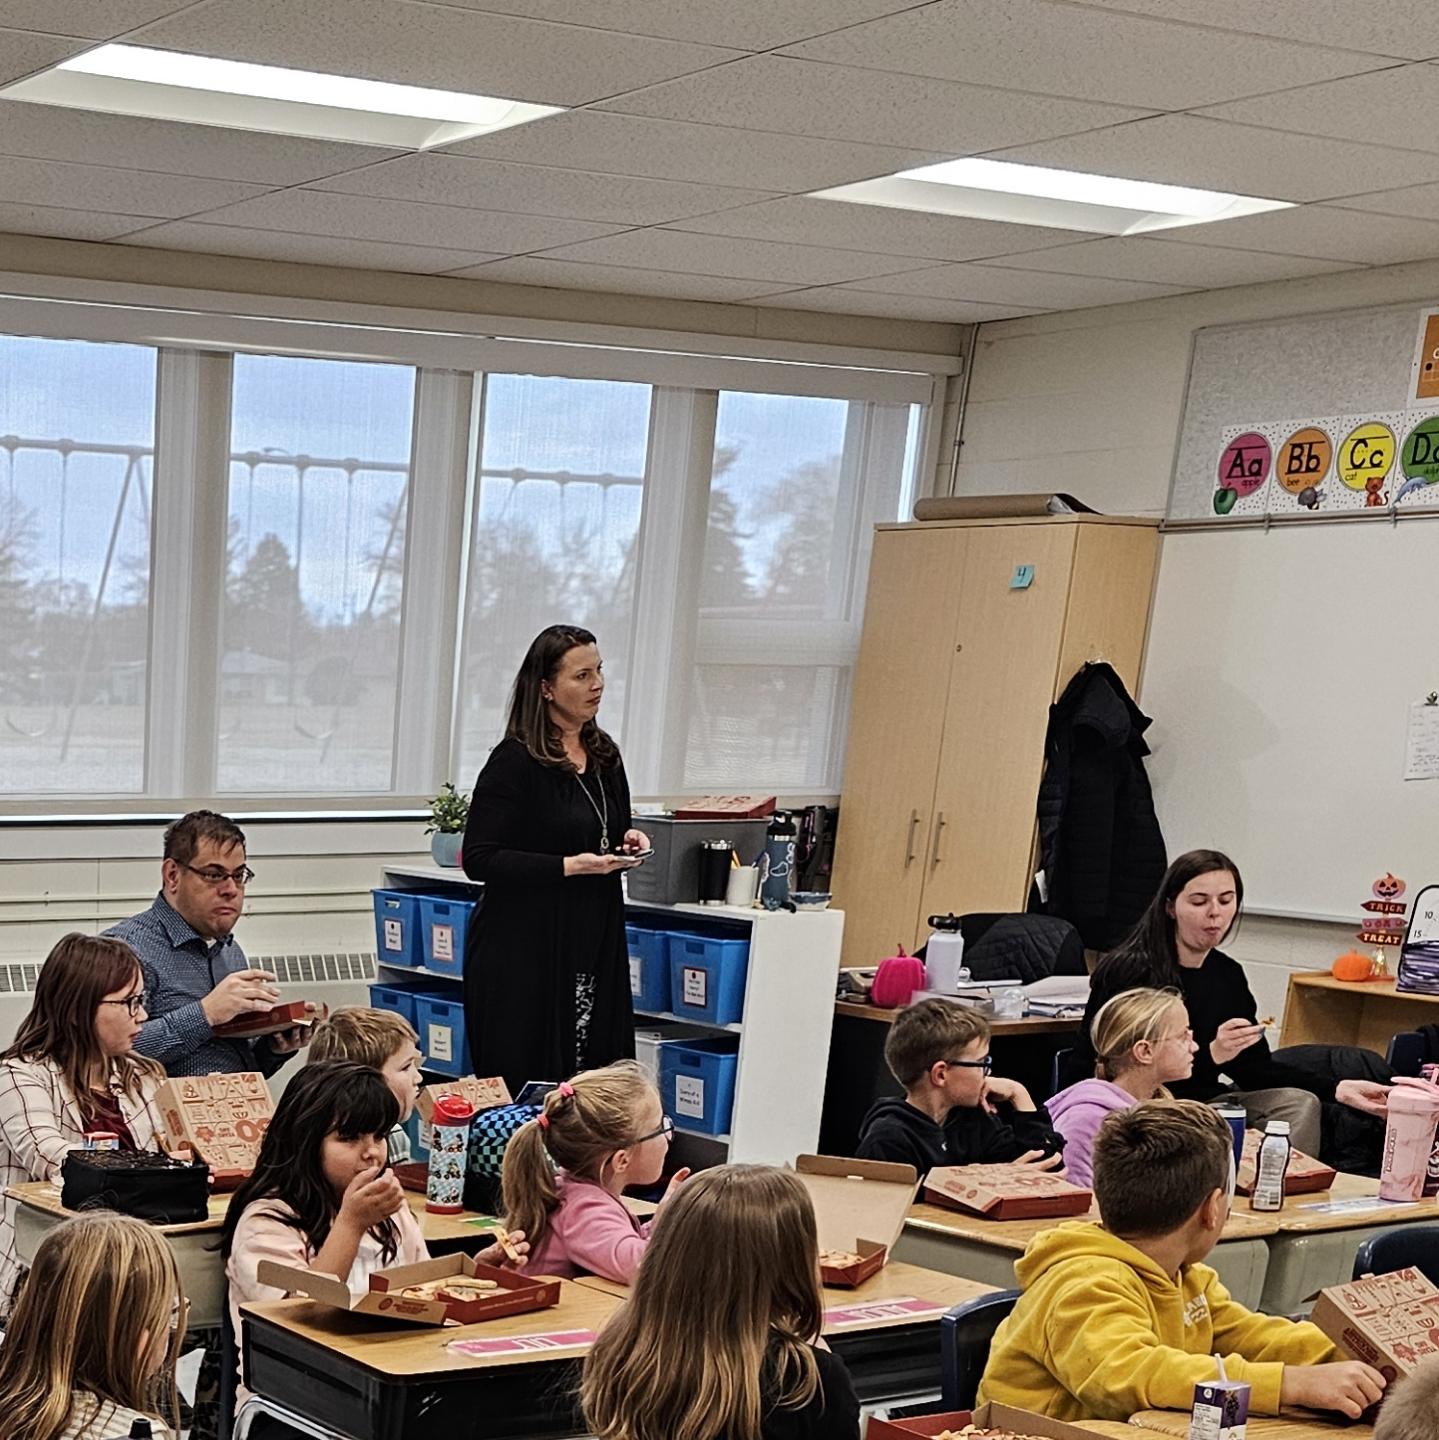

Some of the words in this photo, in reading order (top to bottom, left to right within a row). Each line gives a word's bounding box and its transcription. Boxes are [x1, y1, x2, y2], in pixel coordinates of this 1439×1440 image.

[1287, 442, 1321, 474] Bb
[1350, 439, 1384, 469] Cc
[1226, 449, 1263, 478] Aa
[1287, 478, 1300, 486] bee
[1370, 902, 1403, 912] TRICK
[1424, 911, 1433, 919] 10
[1363, 933, 1400, 944] TREAT
[1413, 930, 1422, 938] 15
